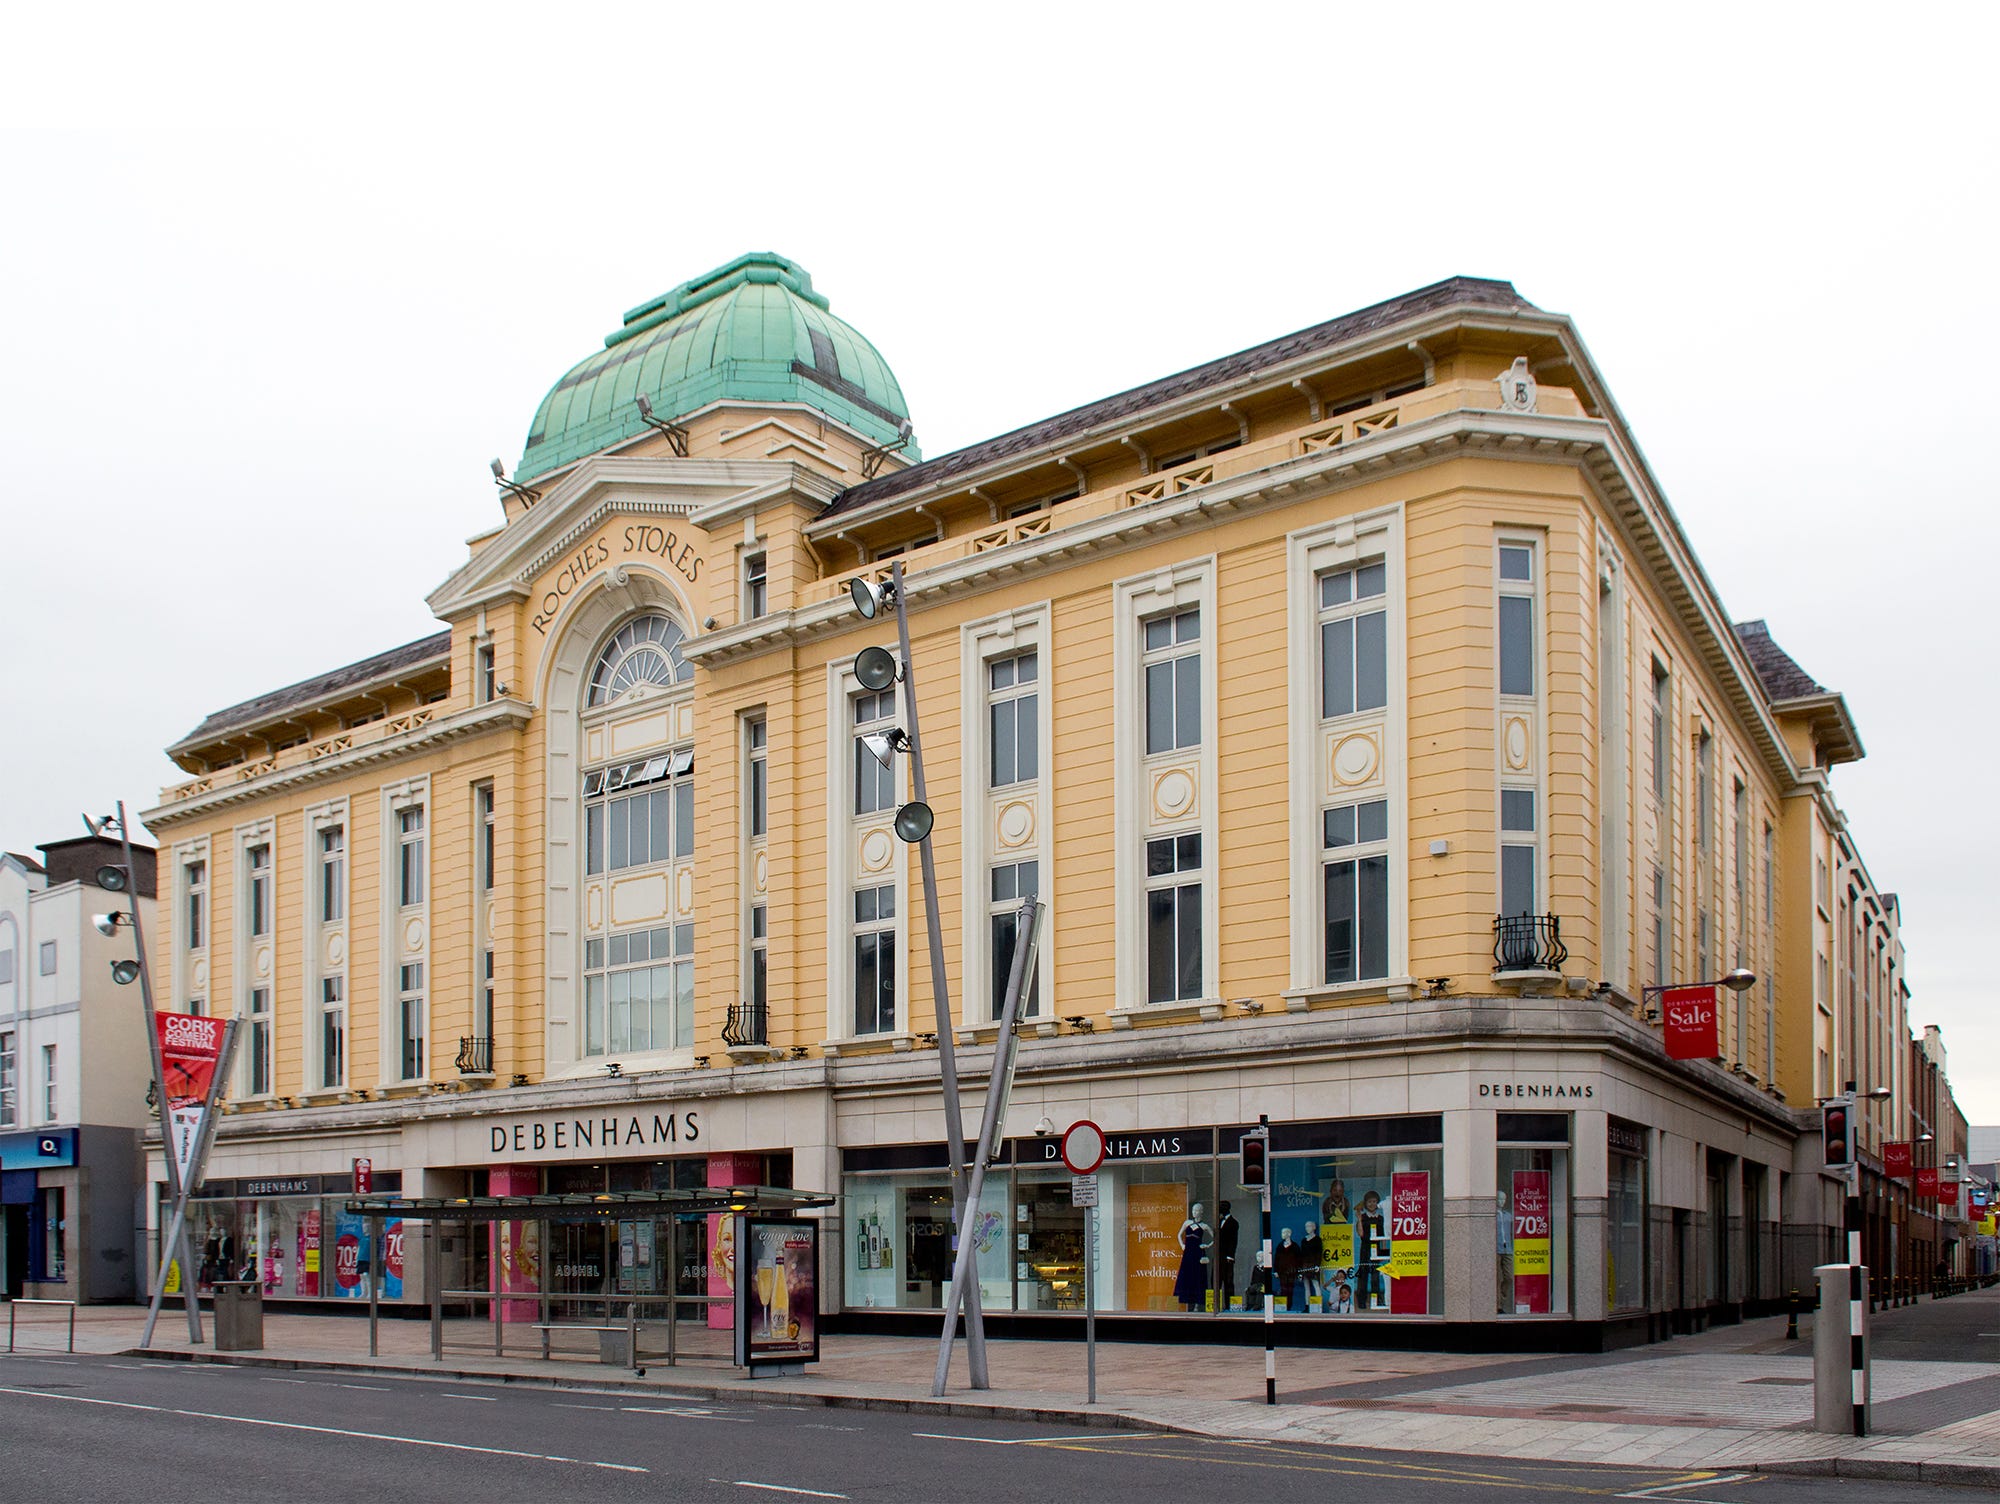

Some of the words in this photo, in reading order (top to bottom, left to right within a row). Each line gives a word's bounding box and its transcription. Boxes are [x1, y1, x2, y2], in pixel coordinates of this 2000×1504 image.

[532, 537, 609, 636] ROCHES
[623, 525, 704, 583] STORES
[1670, 1005, 1711, 1026] Sale
[165, 1016, 216, 1034] CORK
[165, 1029, 216, 1042] COMEDY
[165, 1037, 216, 1050] FESTIVAL
[1479, 1084, 1593, 1098] DEBENHAMS
[491, 1112, 699, 1152] DEBENHAMS
[1045, 1137, 1181, 1159] DNHAMS
[248, 1180, 308, 1194] DEBENHAMS
[1402, 1189, 1419, 1197] Final
[1398, 1201, 1421, 1213] Sale
[1520, 1200, 1543, 1212] Sale
[1393, 1217, 1427, 1235] 70%
[1515, 1216, 1548, 1234] 70%
[791, 1231, 810, 1242] eve
[1138, 1230, 1172, 1243] prom...
[1151, 1248, 1183, 1258] races...
[555, 1264, 600, 1277] ADSHEL
[1130, 1266, 1178, 1281] ...wedding
